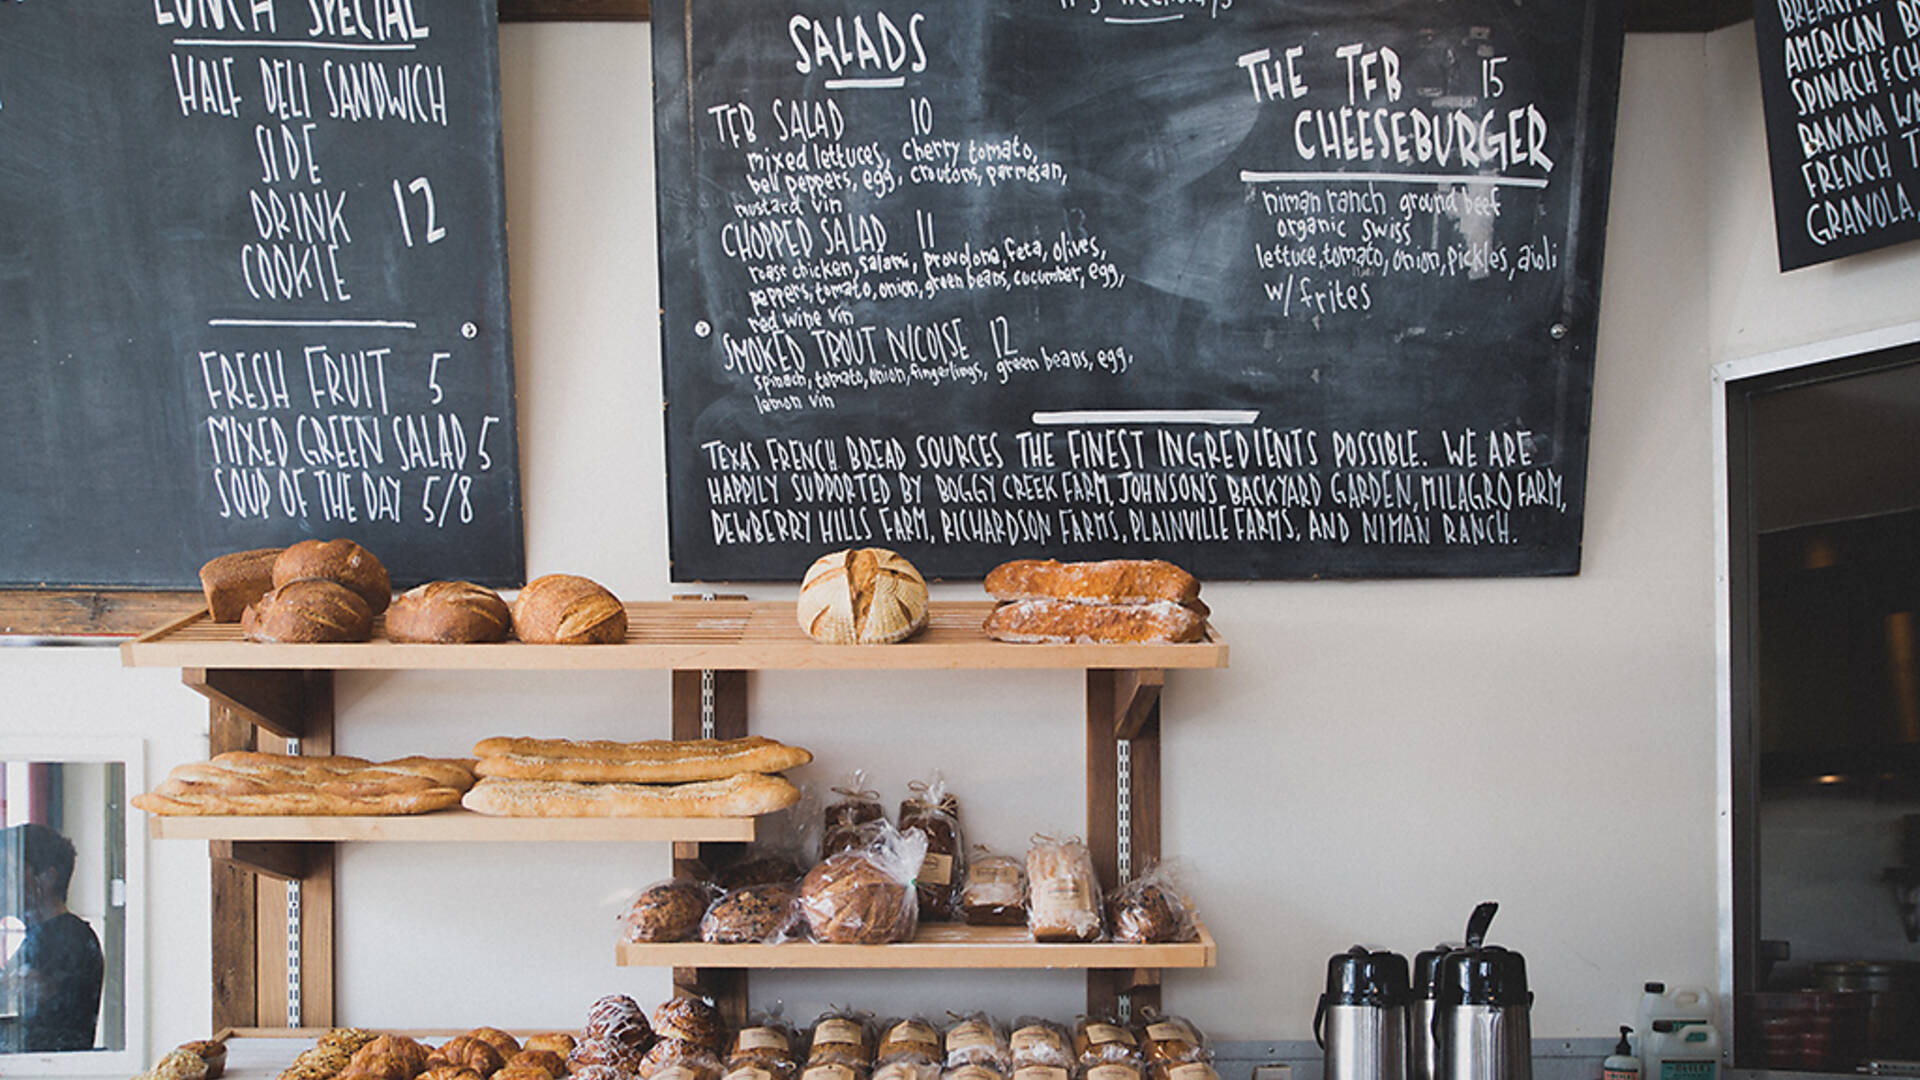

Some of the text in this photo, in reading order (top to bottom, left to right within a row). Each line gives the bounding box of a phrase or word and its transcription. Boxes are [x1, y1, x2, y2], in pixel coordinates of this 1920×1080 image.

[309, 0, 430, 41] SPECIAL
[788, 11, 928, 75] SALADS
[1784, 12, 1886, 79] AMERICAN
[171, 54, 447, 126] HALF DELI SANDWICH
[1238, 43, 1508, 105] THE TFB 15
[1790, 54, 1879, 116] SPINACH
[708, 97, 933, 148] TFB SALAD 10
[1294, 103, 1554, 172] CHEESEBURGER
[1797, 103, 1888, 159] BANANA
[255, 123, 321, 184] SIDE
[746, 135, 1037, 173] mixed lettuces, cherry tomato,
[1801, 141, 1892, 198] FRENCH
[746, 163, 1067, 199] bell peppers, egg, croutons, parmesan,
[1262, 181, 1501, 221] niman ranch ground beef
[249, 177, 446, 247] DRINK 12
[734, 198, 842, 218] mustard vin
[1277, 216, 1412, 246] organic swiss
[721, 209, 934, 262] CHOPPED SALAD 11
[748, 264, 787, 283] roast
[1053, 231, 1107, 260] olives,
[1517, 235, 1557, 271] aioli
[241, 244, 351, 301] COOKIE
[925, 271, 964, 299] green
[1013, 262, 1086, 289] cucumber,
[1088, 262, 1125, 288] egg,
[1300, 276, 1372, 314] frites
[748, 304, 854, 334] red wine vin
[723, 316, 1018, 375] SMOKED TROUT NICOISE 12
[996, 356, 1039, 384] green
[1041, 346, 1094, 371] beans,
[1098, 347, 1134, 374] egg,
[199, 345, 450, 415] FRESH FRUIT 5
[755, 390, 835, 415] lemon vin
[206, 413, 500, 471] MIXED GREEN SALAD 5
[701, 427, 1532, 472] TEXAS FRENCH BREAD SOURCES THE FINEST INGREDIENTS POSSIBLE. WE ARE
[213, 467, 474, 527] SOUP OF THE DAY 5/8
[707, 474, 779, 505] HAPPILY
[790, 474, 891, 504] SUPPORTED
[899, 474, 922, 504] BY
[937, 473, 997, 504] BOGGY
[1002, 473, 1058, 502] CREEK
[1117, 471, 1218, 505] JOHNSON'S
[1226, 473, 1322, 508] BACKYARD
[1420, 472, 1512, 512] MILAGRO
[1518, 472, 1568, 514] FARM,
[710, 506, 1519, 546] DEWBERRY HILLS FARM, RICHARDSON FARMS, PLAINVILLE FARMS, AND NIMAN RANCH.
